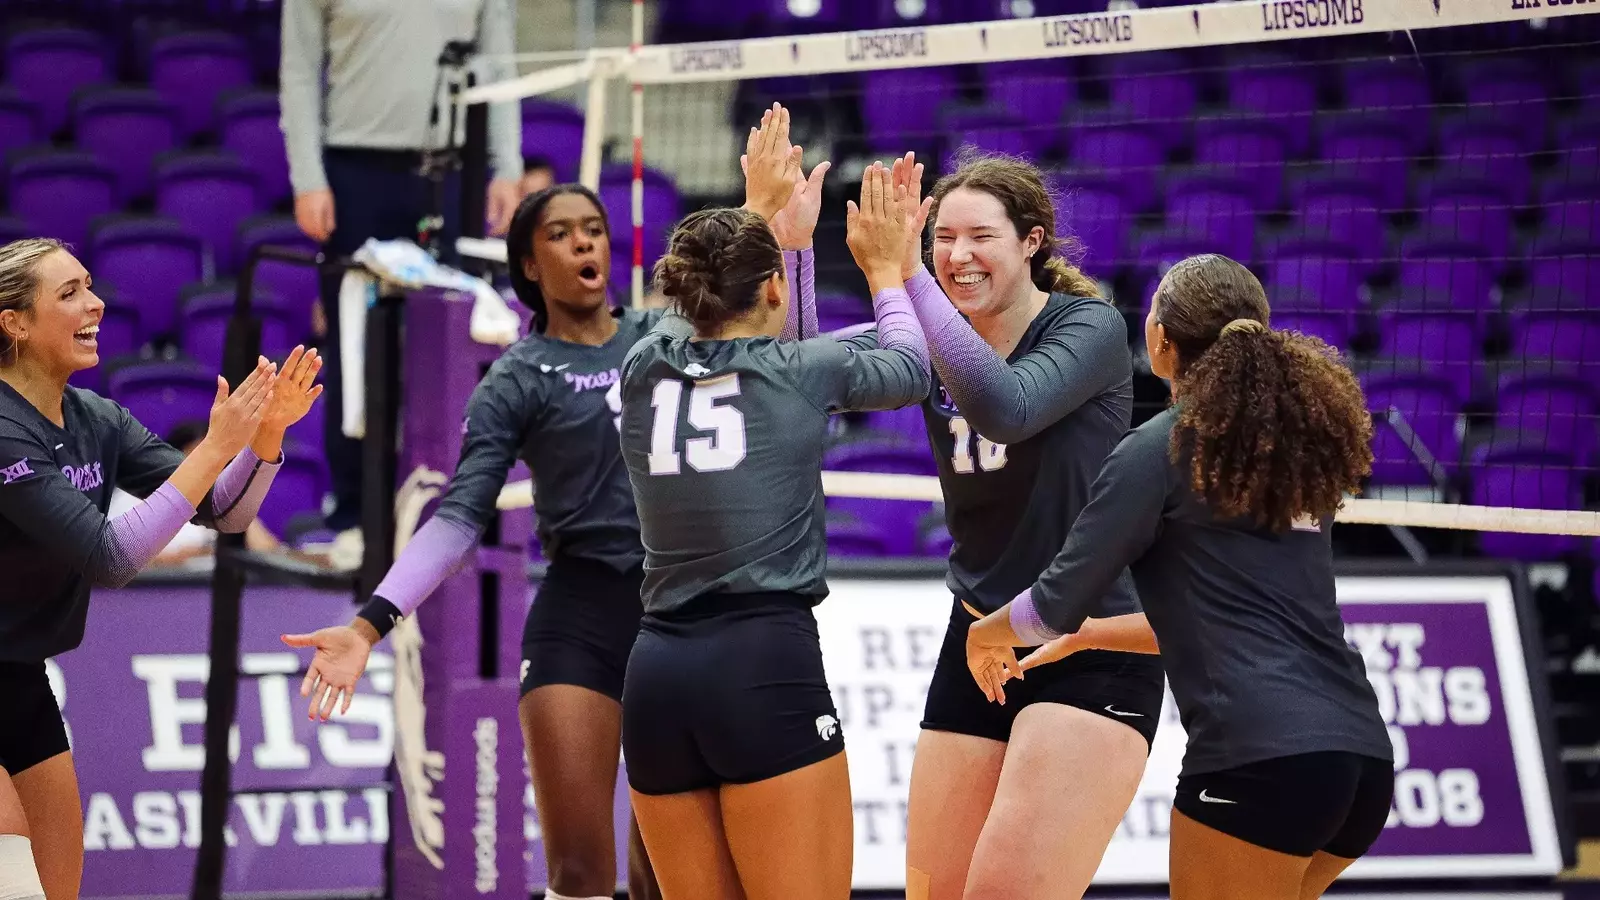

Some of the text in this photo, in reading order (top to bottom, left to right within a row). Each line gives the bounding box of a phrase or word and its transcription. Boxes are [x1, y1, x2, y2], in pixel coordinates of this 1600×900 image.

[1042, 14, 1132, 47] LIPSCOMB
[1262, 0, 1363, 30] LIPSCOMB
[648, 372, 747, 475] 15
[1384, 767, 1484, 828] 08
